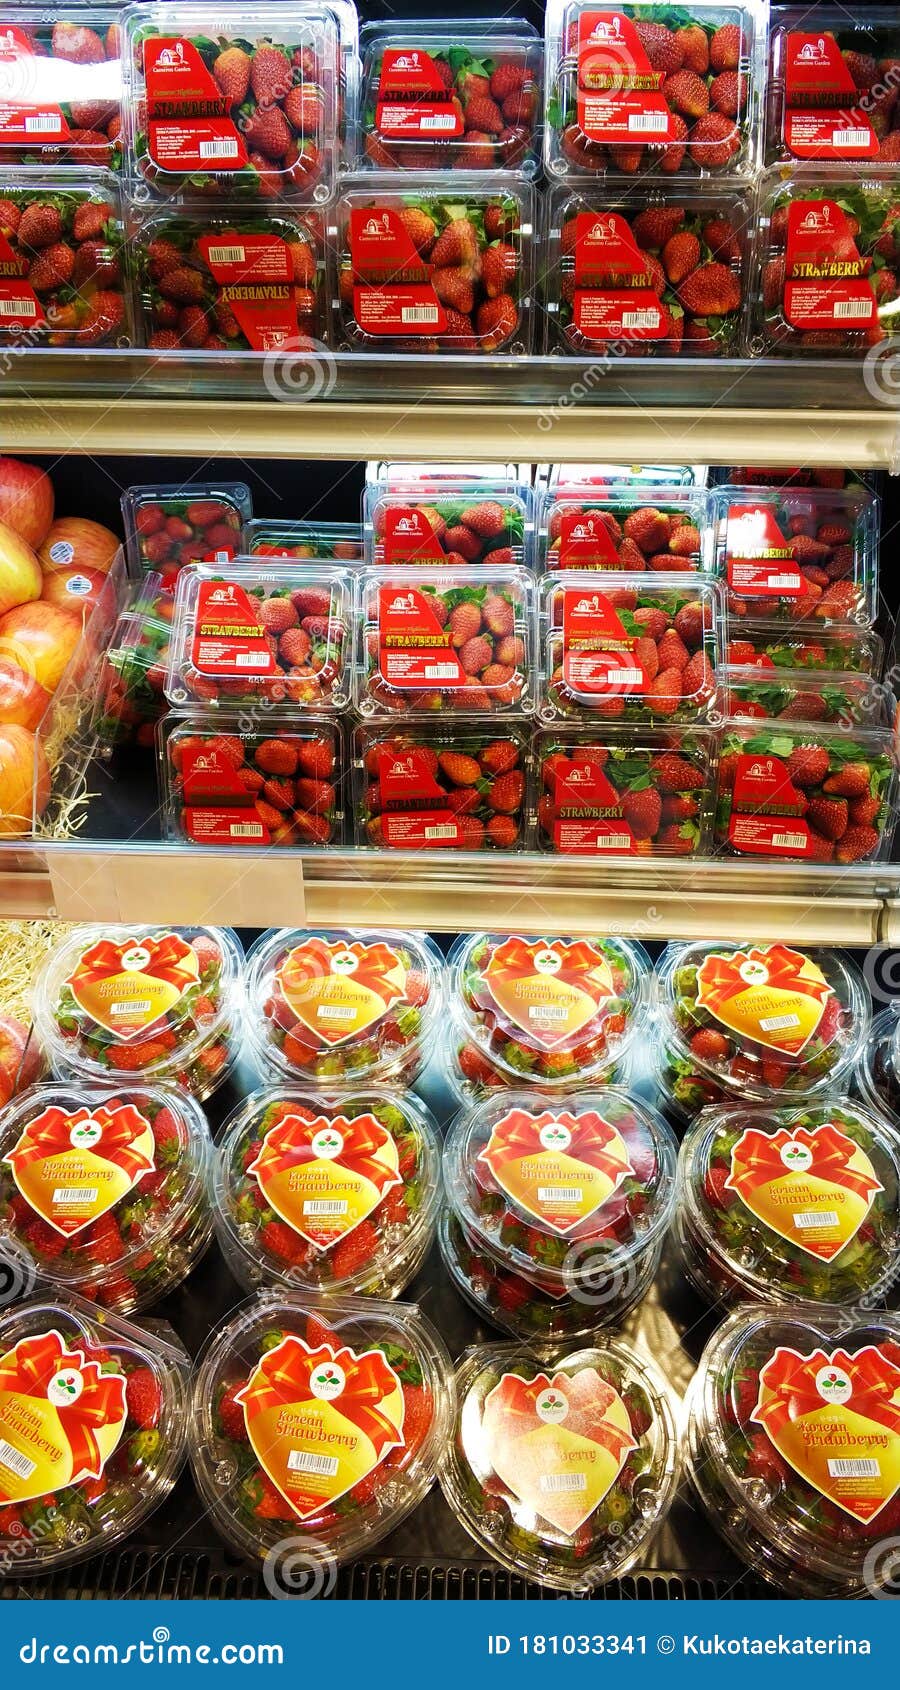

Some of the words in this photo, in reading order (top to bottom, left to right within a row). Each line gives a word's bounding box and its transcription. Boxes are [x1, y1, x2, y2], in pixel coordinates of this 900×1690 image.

[584, 72, 662, 90] STRAWBERRY
[383, 90, 452, 102] STRAWBERRY
[153, 98, 228, 117] STRAWBERRY
[792, 259, 868, 277] STRAWBERRY
[581, 271, 654, 288] STRAWBERRY
[221, 285, 290, 302] STRAWBERRY
[732, 546, 794, 559] STRAWBERRY
[200, 624, 266, 637] STRAWBERRY
[385, 634, 450, 648] STRAWBERRY
[568, 637, 635, 652] STRAWBERRY
[559, 806, 625, 818] STRAWBERRY
[43, 1161, 84, 1171] Korean
[41, 1168, 114, 1182] Strawberry
[289, 1171, 330, 1181] Korean
[288, 1180, 362, 1193] Strawberry
[768, 1183, 810, 1196] Korean
[770, 1190, 846, 1206] Strawberry
[6, 1397, 44, 1430] Korean
[278, 1410, 324, 1428] Korean
[0, 1406, 63, 1464] Strawberry
[801, 1420, 849, 1435] Korean
[275, 1421, 359, 1450] Strawberry
[803, 1432, 890, 1449] Strawberry
